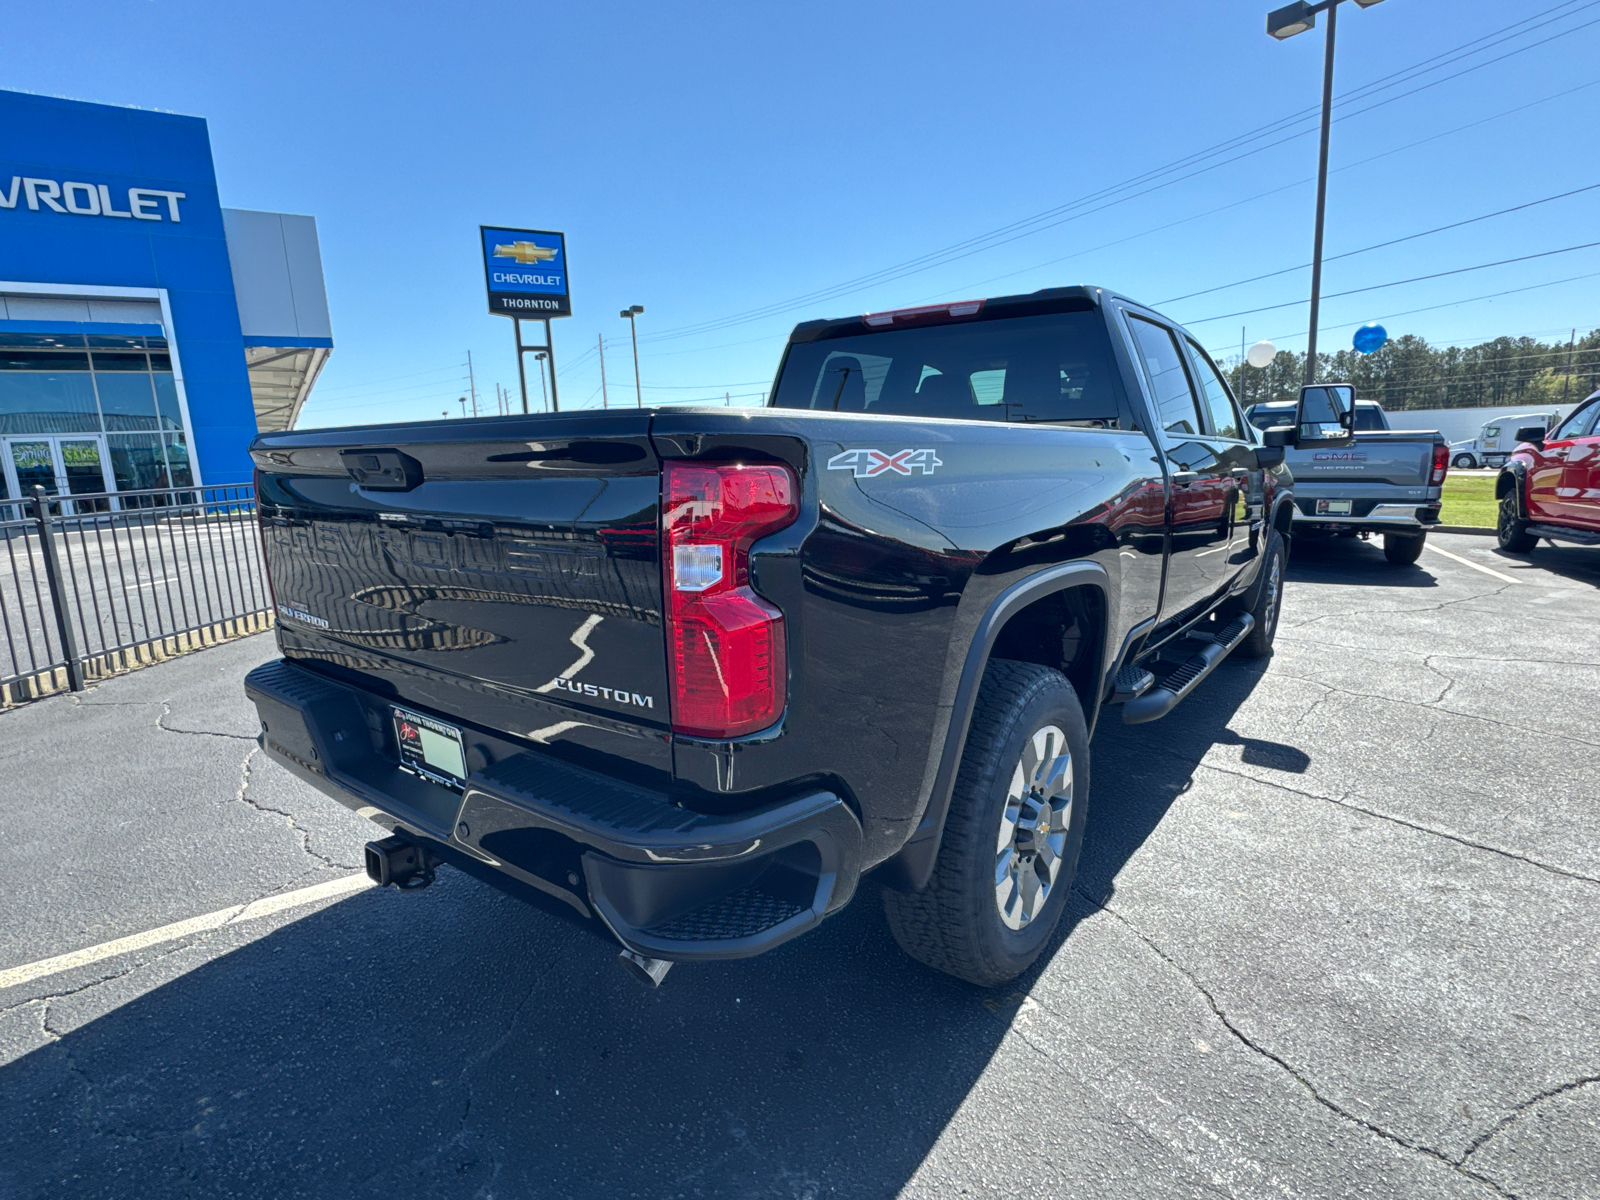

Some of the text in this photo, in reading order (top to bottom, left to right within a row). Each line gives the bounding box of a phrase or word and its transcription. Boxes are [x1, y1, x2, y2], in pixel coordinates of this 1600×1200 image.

[493, 272, 561, 286] CHEVROLET
[502, 298, 559, 309] THORNTON
[13, 446, 52, 462] Spring
[1313, 452, 1368, 462] GMC
[277, 604, 330, 629] SILVERADO
[554, 677, 653, 708] CUSTOM
